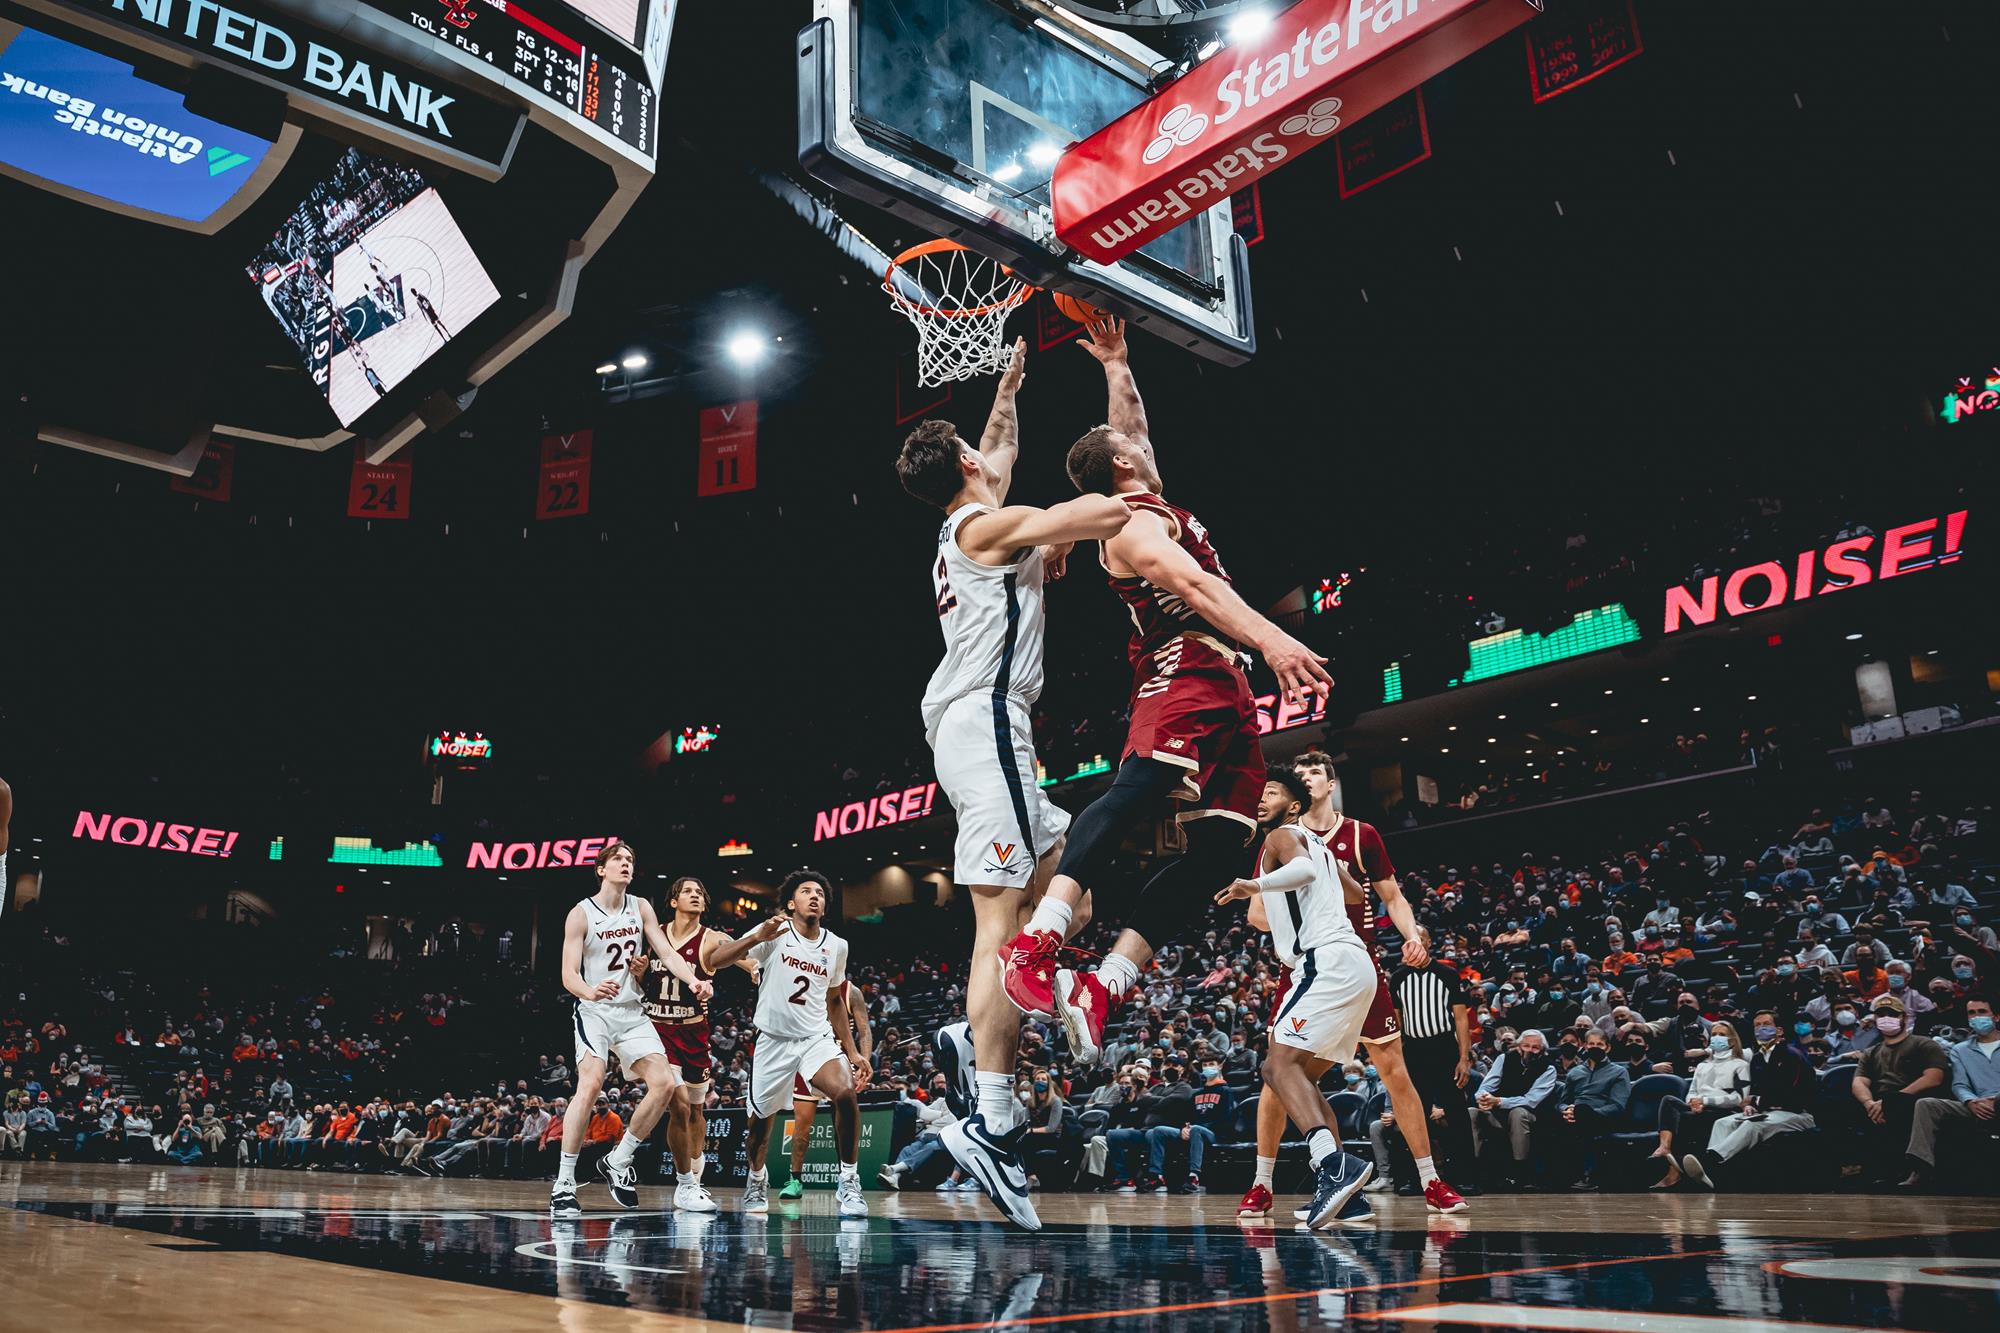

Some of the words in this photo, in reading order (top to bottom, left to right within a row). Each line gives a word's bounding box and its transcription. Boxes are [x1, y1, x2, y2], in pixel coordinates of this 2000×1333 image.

[411, 12, 436, 34] TOL
[440, 27, 448, 40] 2
[456, 34, 480, 55] FLS
[485, 51, 494, 63] 4
[516, 30, 536, 49] FG
[514, 61, 532, 79] FT
[515, 46, 541, 68] 3PT
[1214, 0, 1438, 125] StateFa
[0, 71, 96, 118] Bank
[302, 41, 456, 138] BANK
[588, 73, 599, 86] 11
[614, 89, 622, 101] 0
[640, 106, 648, 118] 2
[590, 61, 598, 73] 3
[614, 78, 622, 89] 4
[640, 95, 648, 106] 0
[611, 65, 627, 81] PTS
[637, 82, 652, 97] FLS
[587, 84, 599, 98] 12
[613, 100, 621, 112] 0
[584, 107, 598, 121] 51
[585, 96, 598, 109] 33
[611, 111, 623, 126] 14
[639, 128, 647, 140] 2
[53, 108, 197, 165] Atlantic
[101, 107, 204, 156] Union
[366, 471, 398, 480] STALEY
[715, 457, 739, 488] 11
[361, 483, 398, 512] 24
[546, 482, 579, 512] 22
[1663, 509, 1968, 634] NOISE!
[436, 742, 489, 757] NOISE!
[812, 782, 938, 842] NOISE!
[72, 810, 240, 858] NOISE!
[596, 926, 640, 941] VIRGINIA
[606, 940, 637, 972] 23
[781, 953, 828, 978] VIRGINIA
[660, 976, 681, 1001] 11
[788, 975, 810, 1006] 2
[645, 1003, 696, 1018] COLLEGE
[812, 1163, 829, 1173] YOUR
